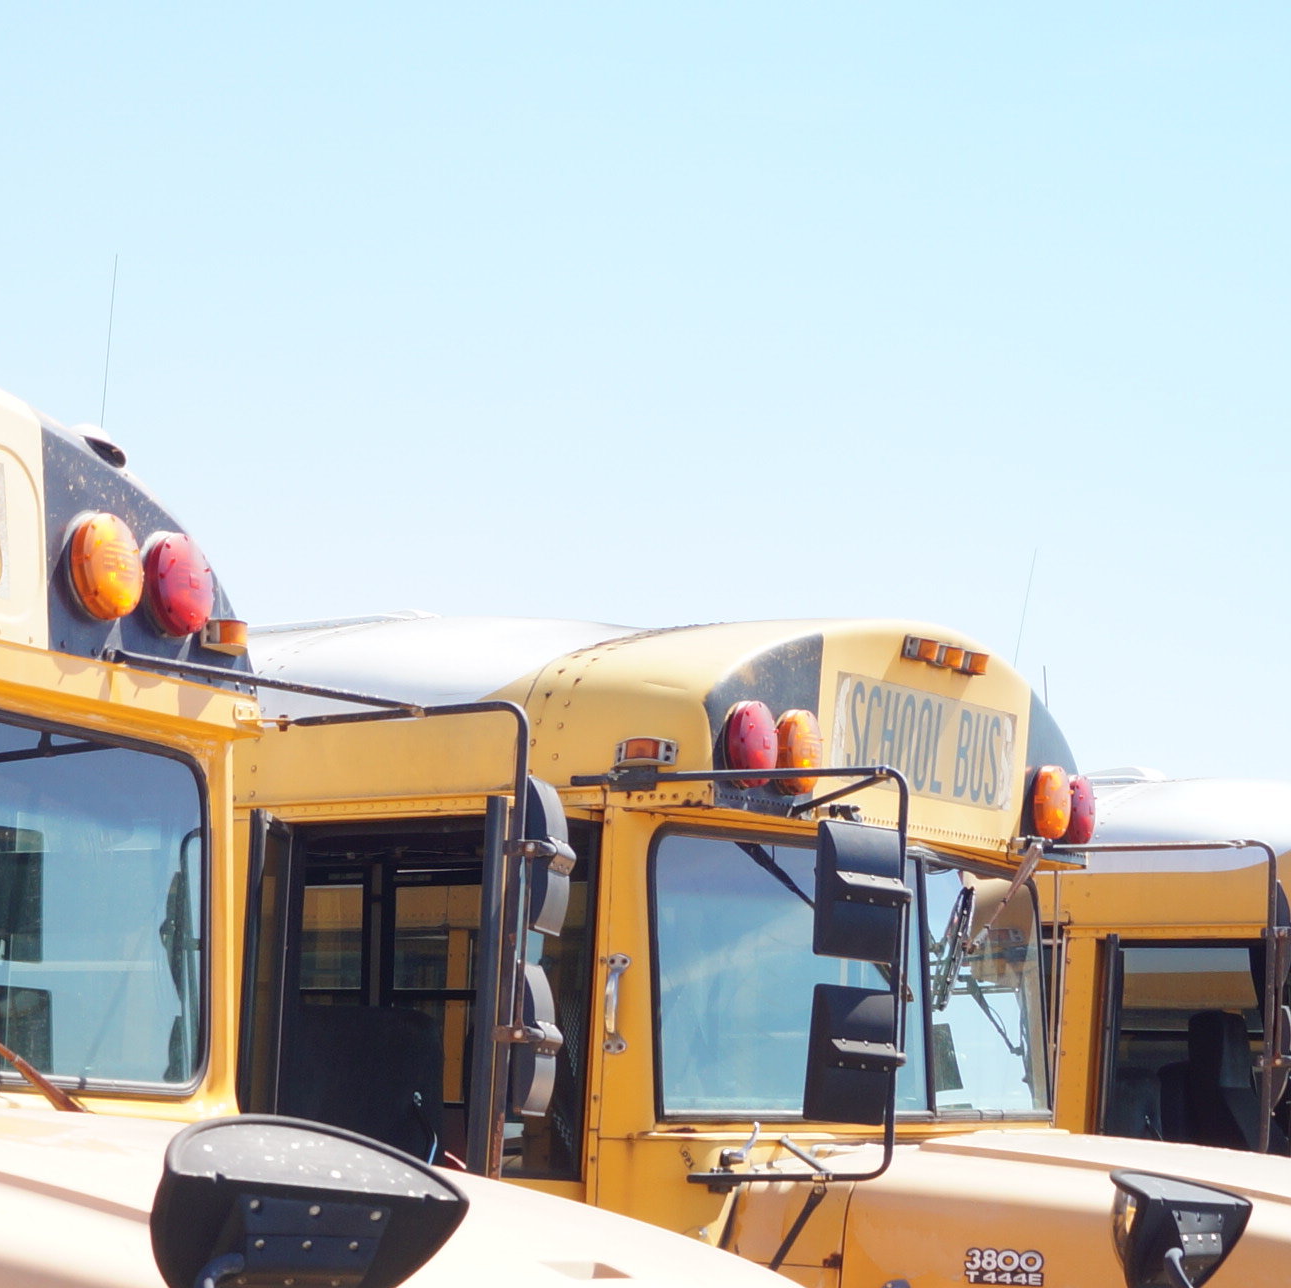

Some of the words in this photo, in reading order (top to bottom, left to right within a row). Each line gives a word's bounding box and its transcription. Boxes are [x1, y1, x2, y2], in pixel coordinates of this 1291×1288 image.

[845, 680, 942, 795] SCHOOL
[952, 708, 1002, 805] BUS
[964, 1247, 1044, 1273] 3800
